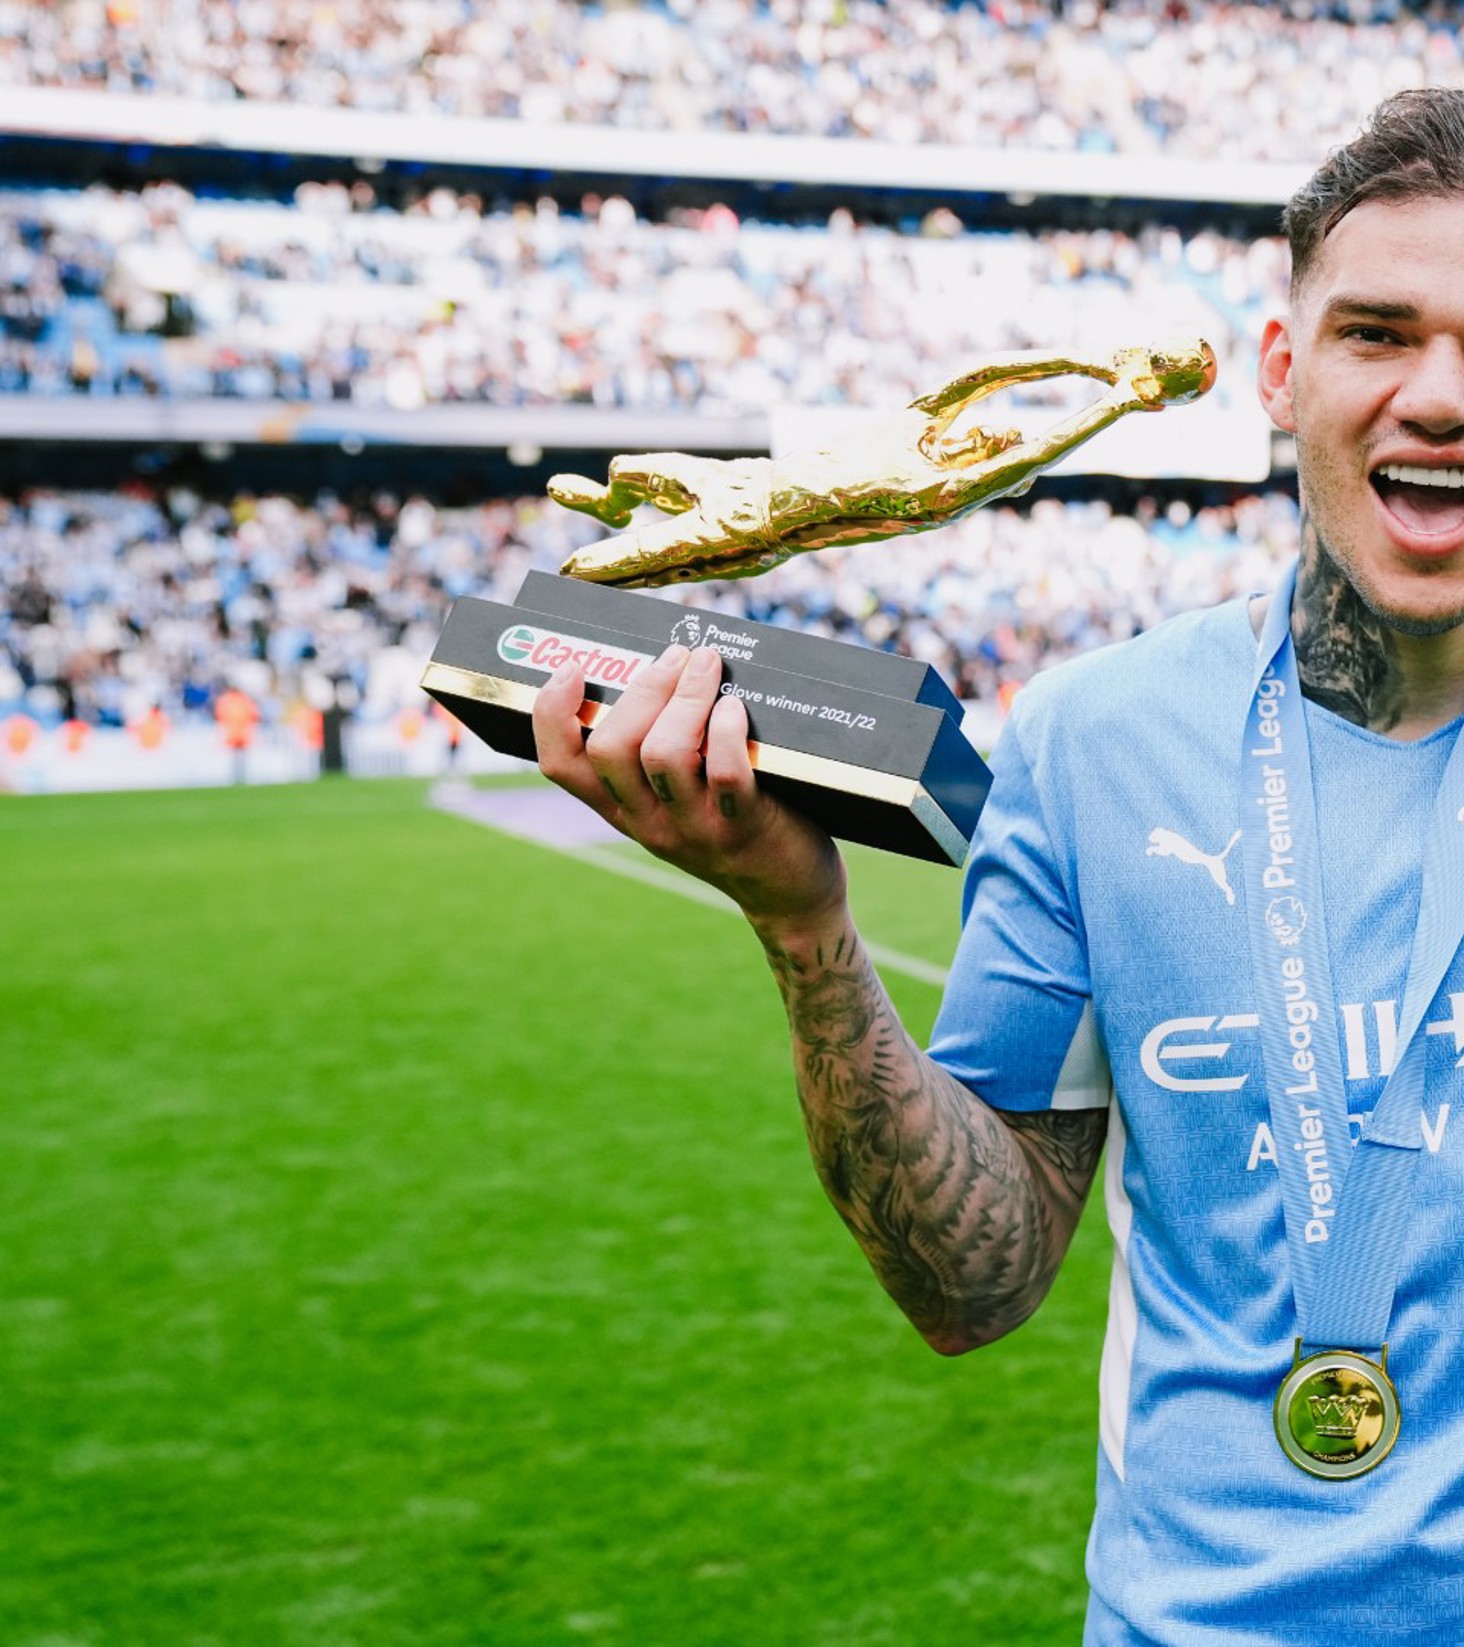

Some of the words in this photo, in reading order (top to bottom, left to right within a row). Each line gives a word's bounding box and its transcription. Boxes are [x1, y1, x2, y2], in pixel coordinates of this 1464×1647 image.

[531, 636, 642, 686] Castrol
[701, 636, 754, 662] League
[705, 624, 760, 649] Premier
[720, 682, 764, 703] Glove
[766, 694, 818, 717] winner
[818, 705, 878, 731] 2021/22
[1251, 664, 1287, 757] Leag
[1256, 764, 1297, 889] Premier
[1282, 955, 1319, 1095] League
[1294, 1104, 1336, 1244] Premier
